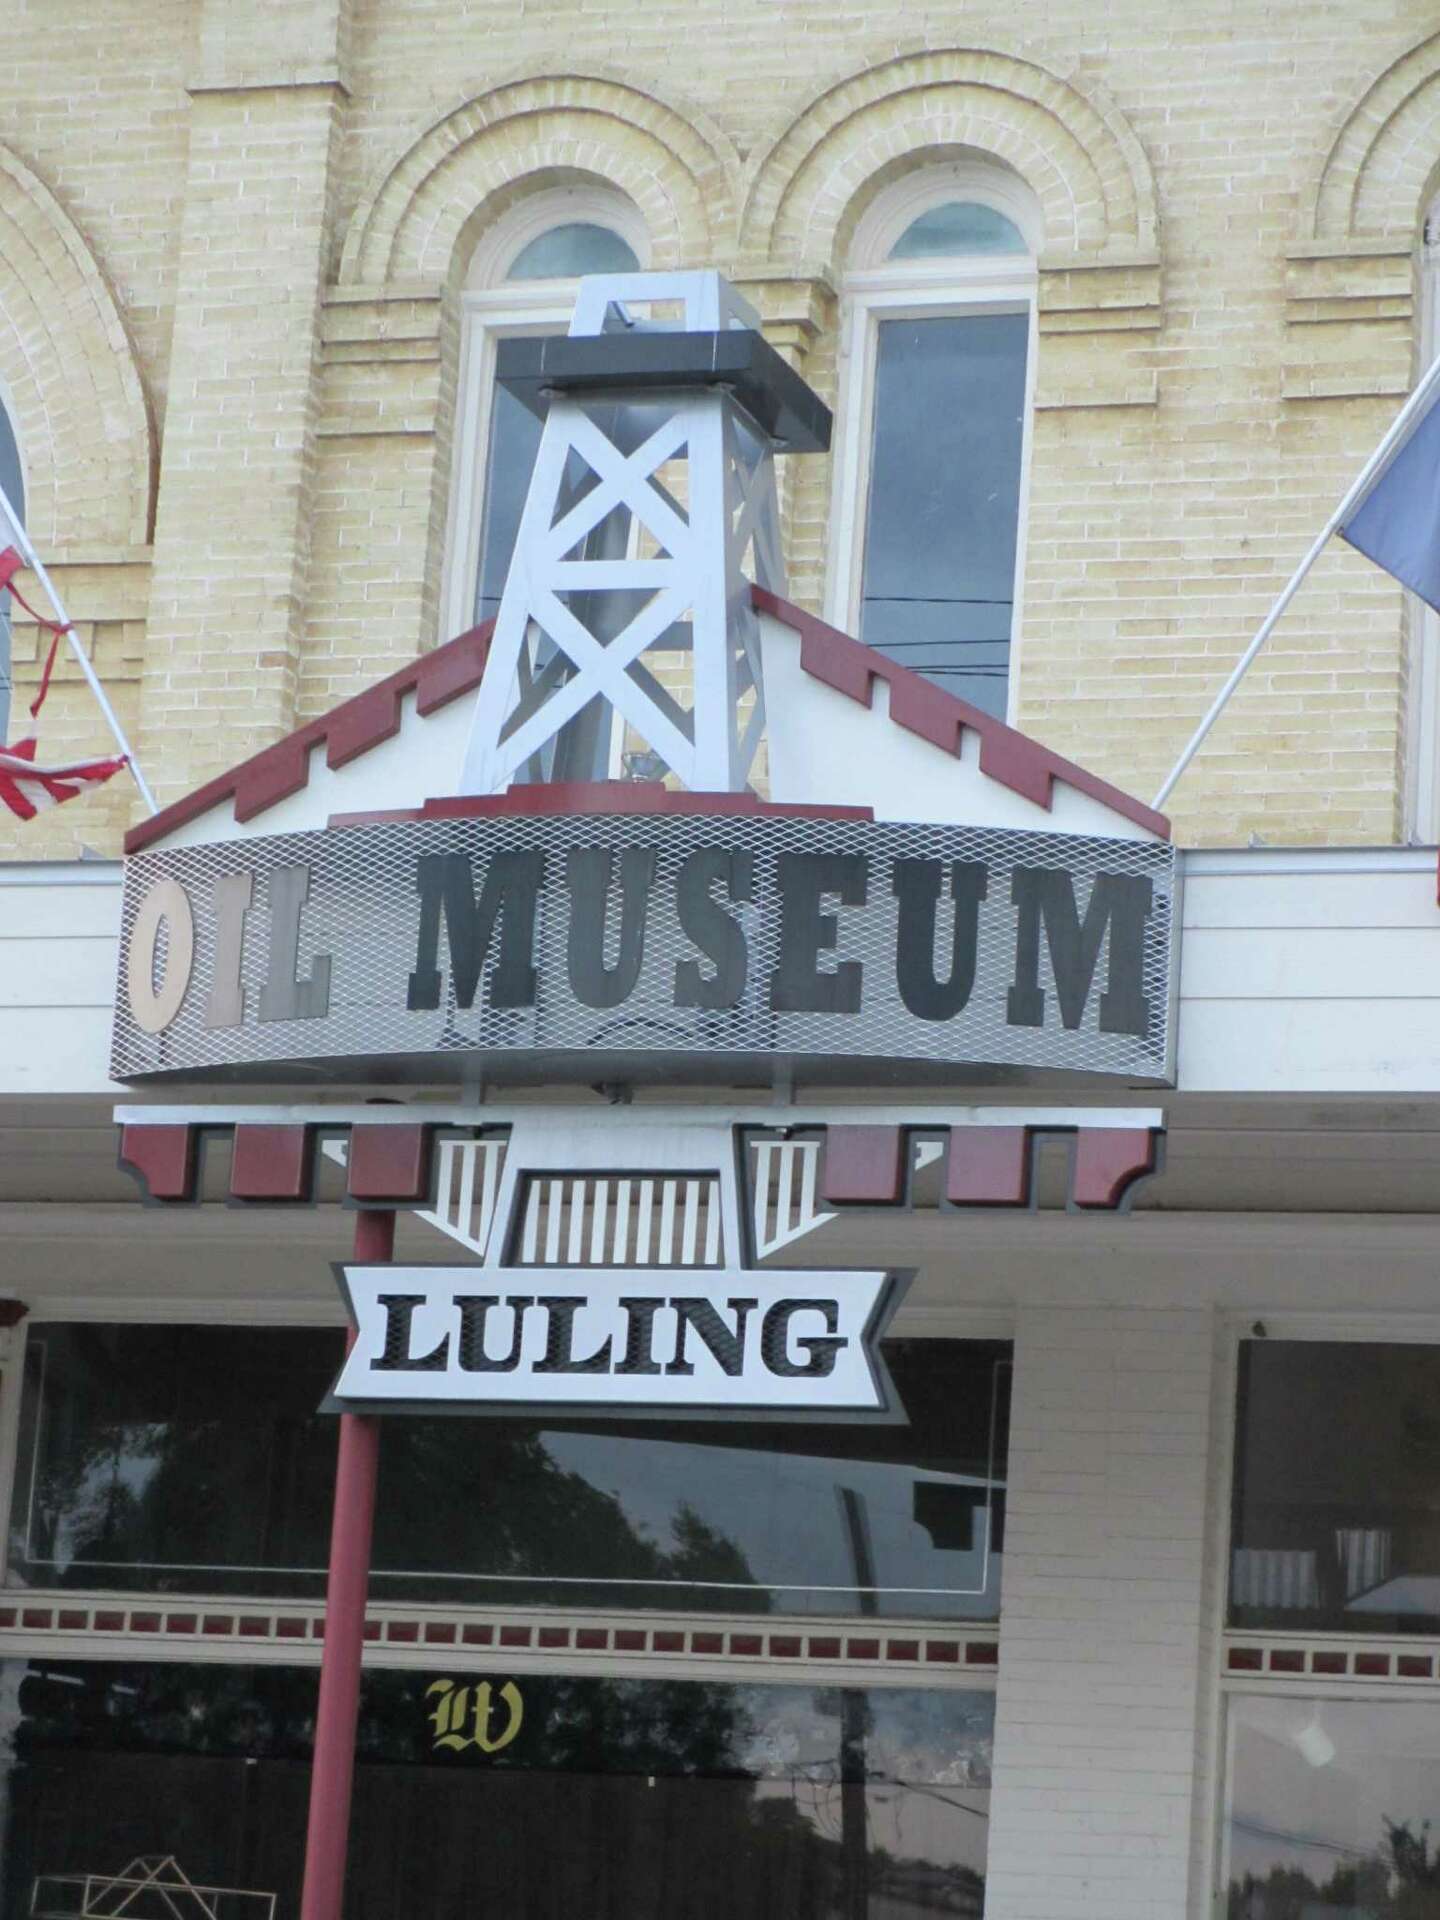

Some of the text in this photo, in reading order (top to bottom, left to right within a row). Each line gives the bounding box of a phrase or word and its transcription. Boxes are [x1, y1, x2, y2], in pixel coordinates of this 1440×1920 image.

[128, 847, 1154, 1036] OIL MUSEUM
[369, 1293, 849, 1378] LULING
